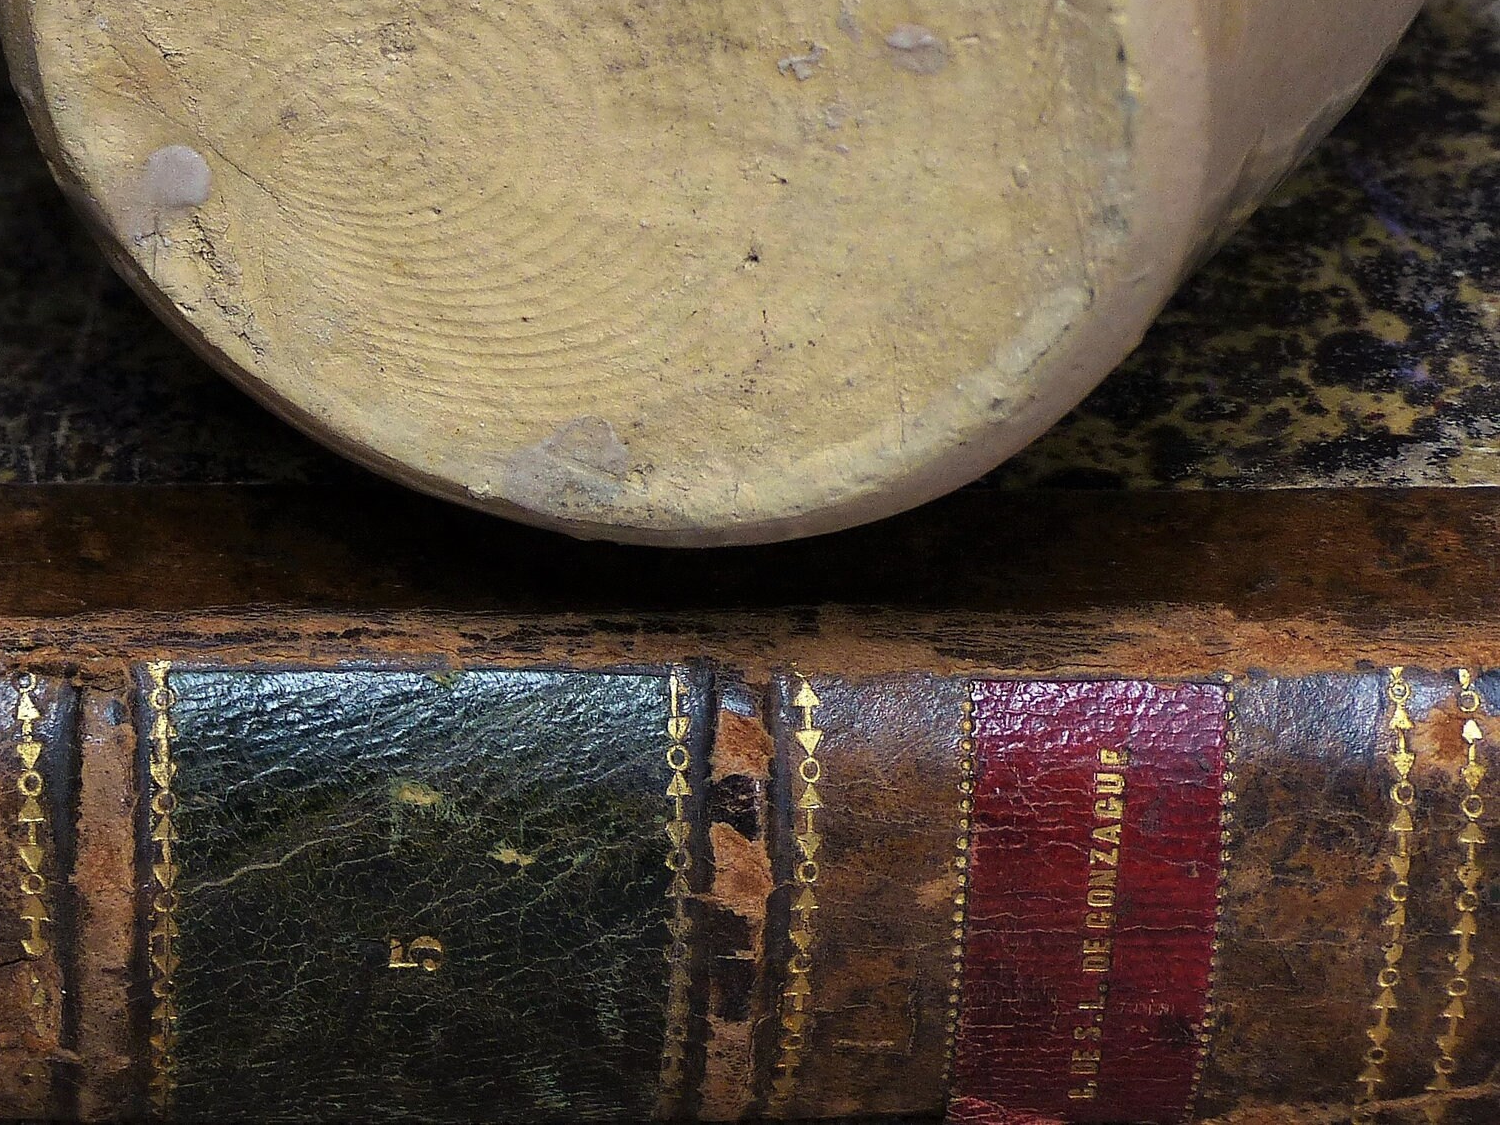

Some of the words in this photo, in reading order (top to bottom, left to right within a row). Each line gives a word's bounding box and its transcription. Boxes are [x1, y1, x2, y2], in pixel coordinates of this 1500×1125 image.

[1085, 748, 1130, 929] GONZAGUE
[388, 935, 444, 972] 5
[1082, 938, 1112, 973] DE
[1077, 982, 1107, 1010] L.
[1073, 1013, 1104, 1041] S.
[1069, 1050, 1101, 1075] DE
